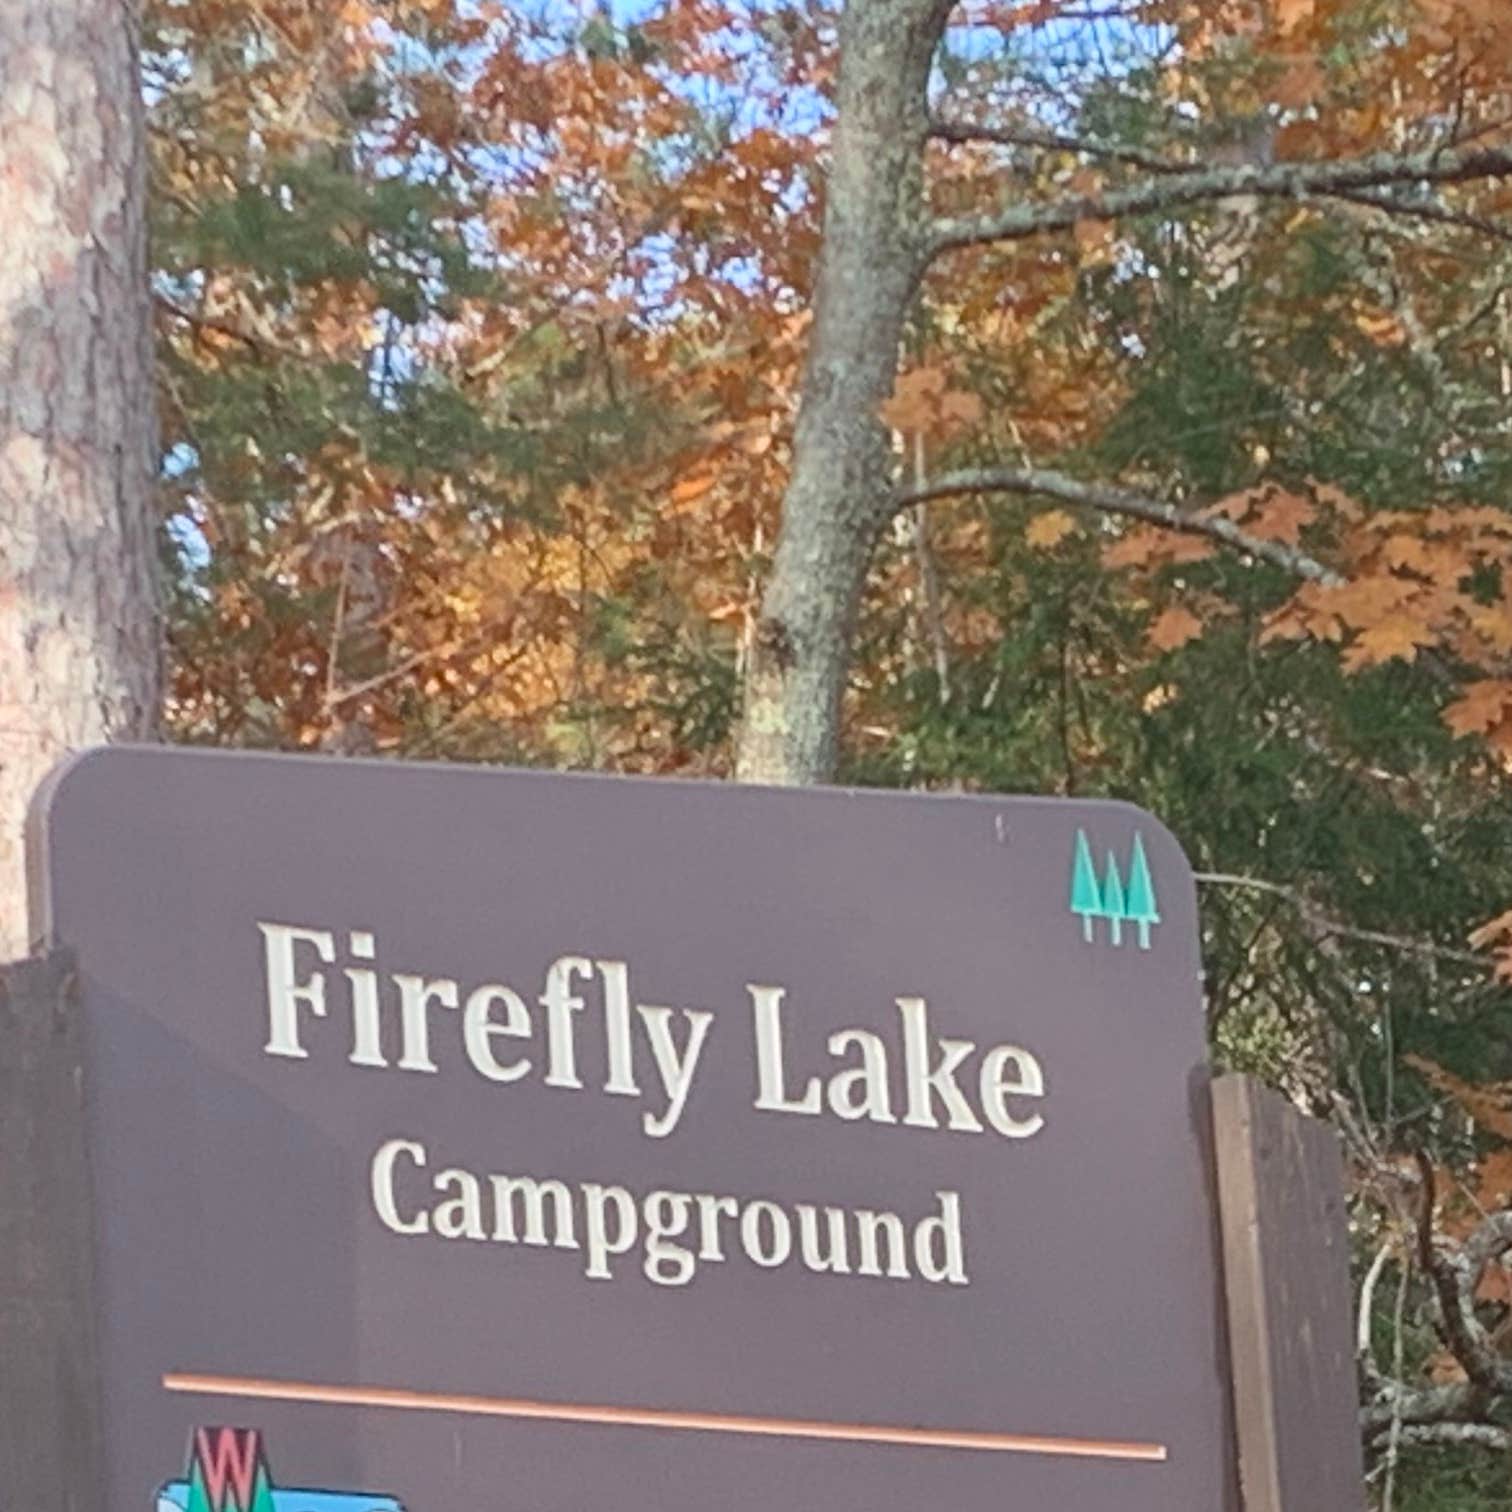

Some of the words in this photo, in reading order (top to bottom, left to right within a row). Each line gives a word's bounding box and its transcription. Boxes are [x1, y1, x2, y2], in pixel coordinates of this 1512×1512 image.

[256, 921, 714, 1138] Firefly
[746, 983, 1046, 1139] Lake
[371, 1138, 970, 1286] Campground
